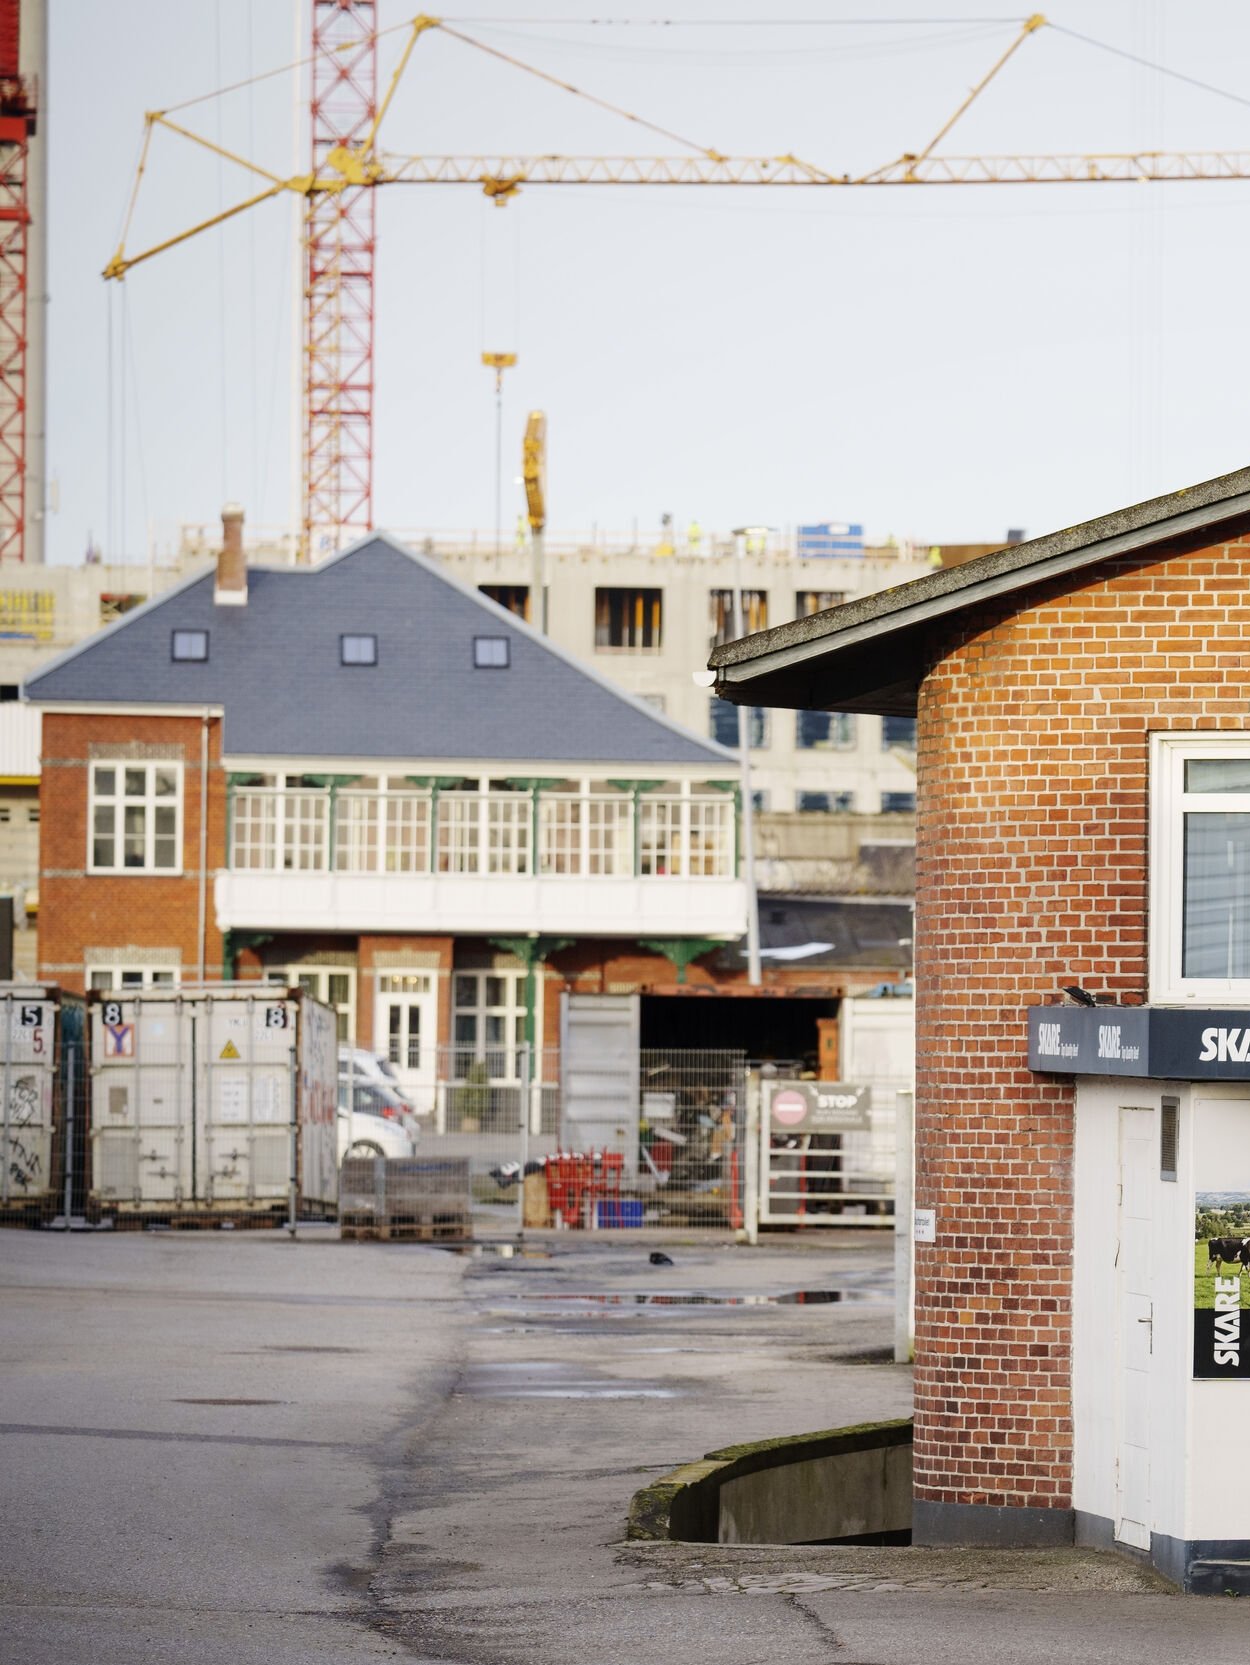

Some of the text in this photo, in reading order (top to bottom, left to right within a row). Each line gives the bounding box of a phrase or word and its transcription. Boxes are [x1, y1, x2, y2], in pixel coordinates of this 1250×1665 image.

[24, 1005, 39, 1026] 5
[104, 1003, 120, 1026] 8
[269, 1008, 285, 1028] 8
[1038, 1023, 1061, 1056] SKARE
[1098, 1025, 1121, 1059] SKARE
[817, 1094, 858, 1108] STOP
[1213, 1276, 1241, 1367] SKARE
